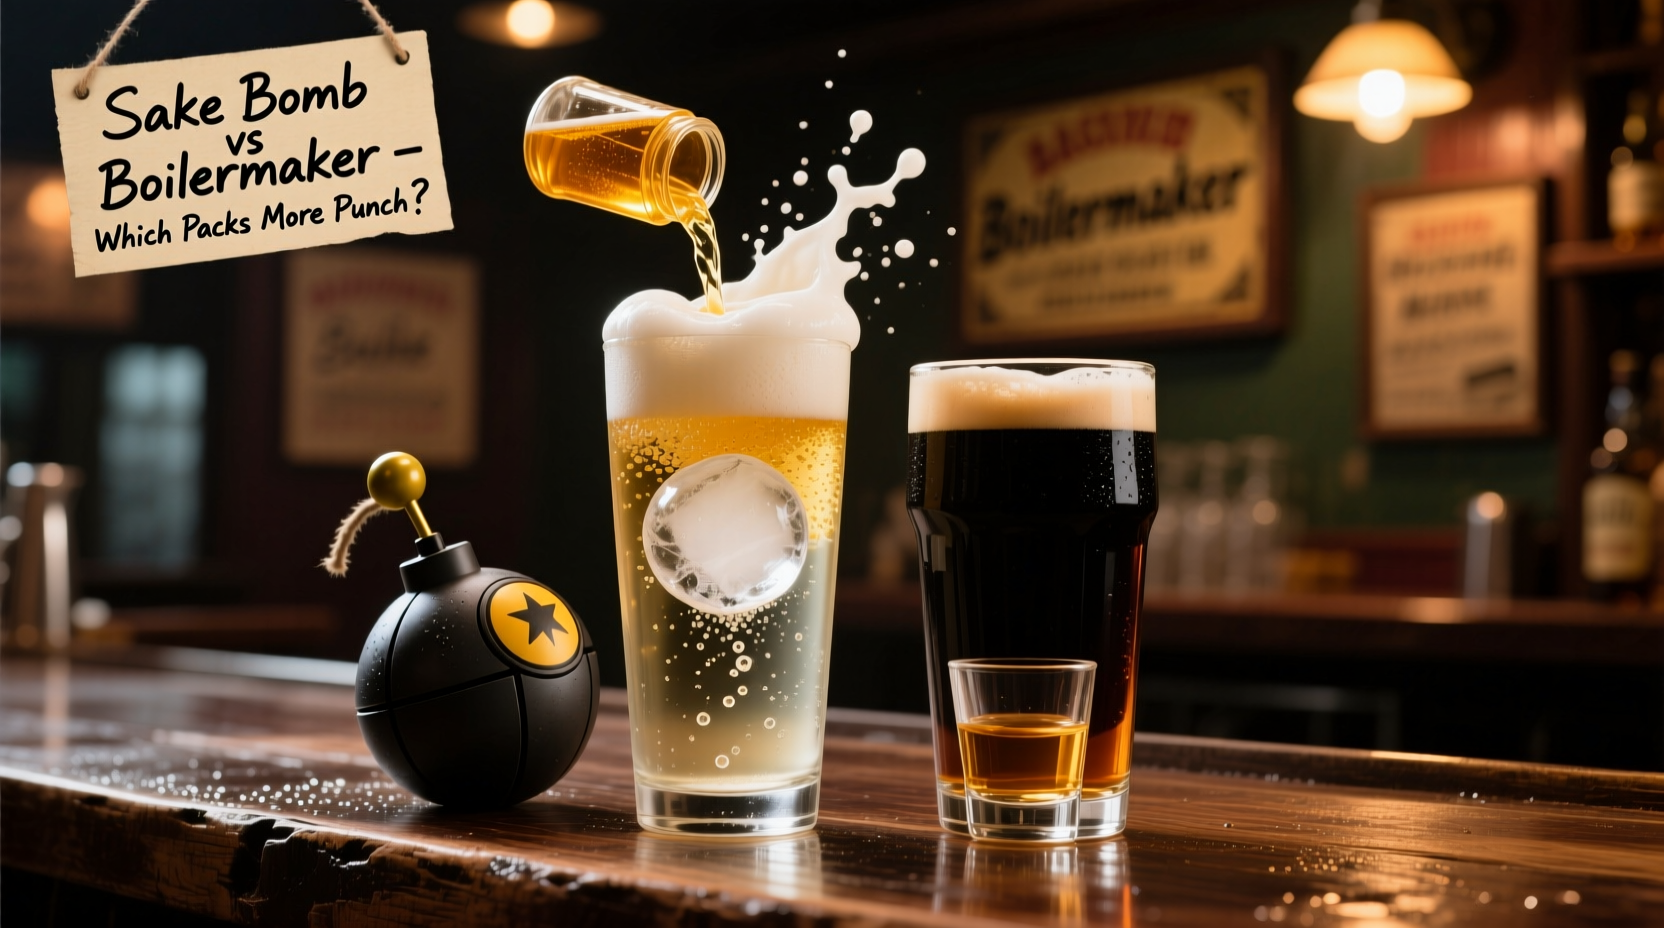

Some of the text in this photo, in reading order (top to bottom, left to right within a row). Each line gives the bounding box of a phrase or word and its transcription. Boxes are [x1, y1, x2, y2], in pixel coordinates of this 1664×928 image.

[102, 60, 368, 140] Sake Bomb
[97, 136, 381, 211] Boilermaker
[225, 129, 264, 157] vs
[94, 177, 430, 253] Which Packs More Punch?
